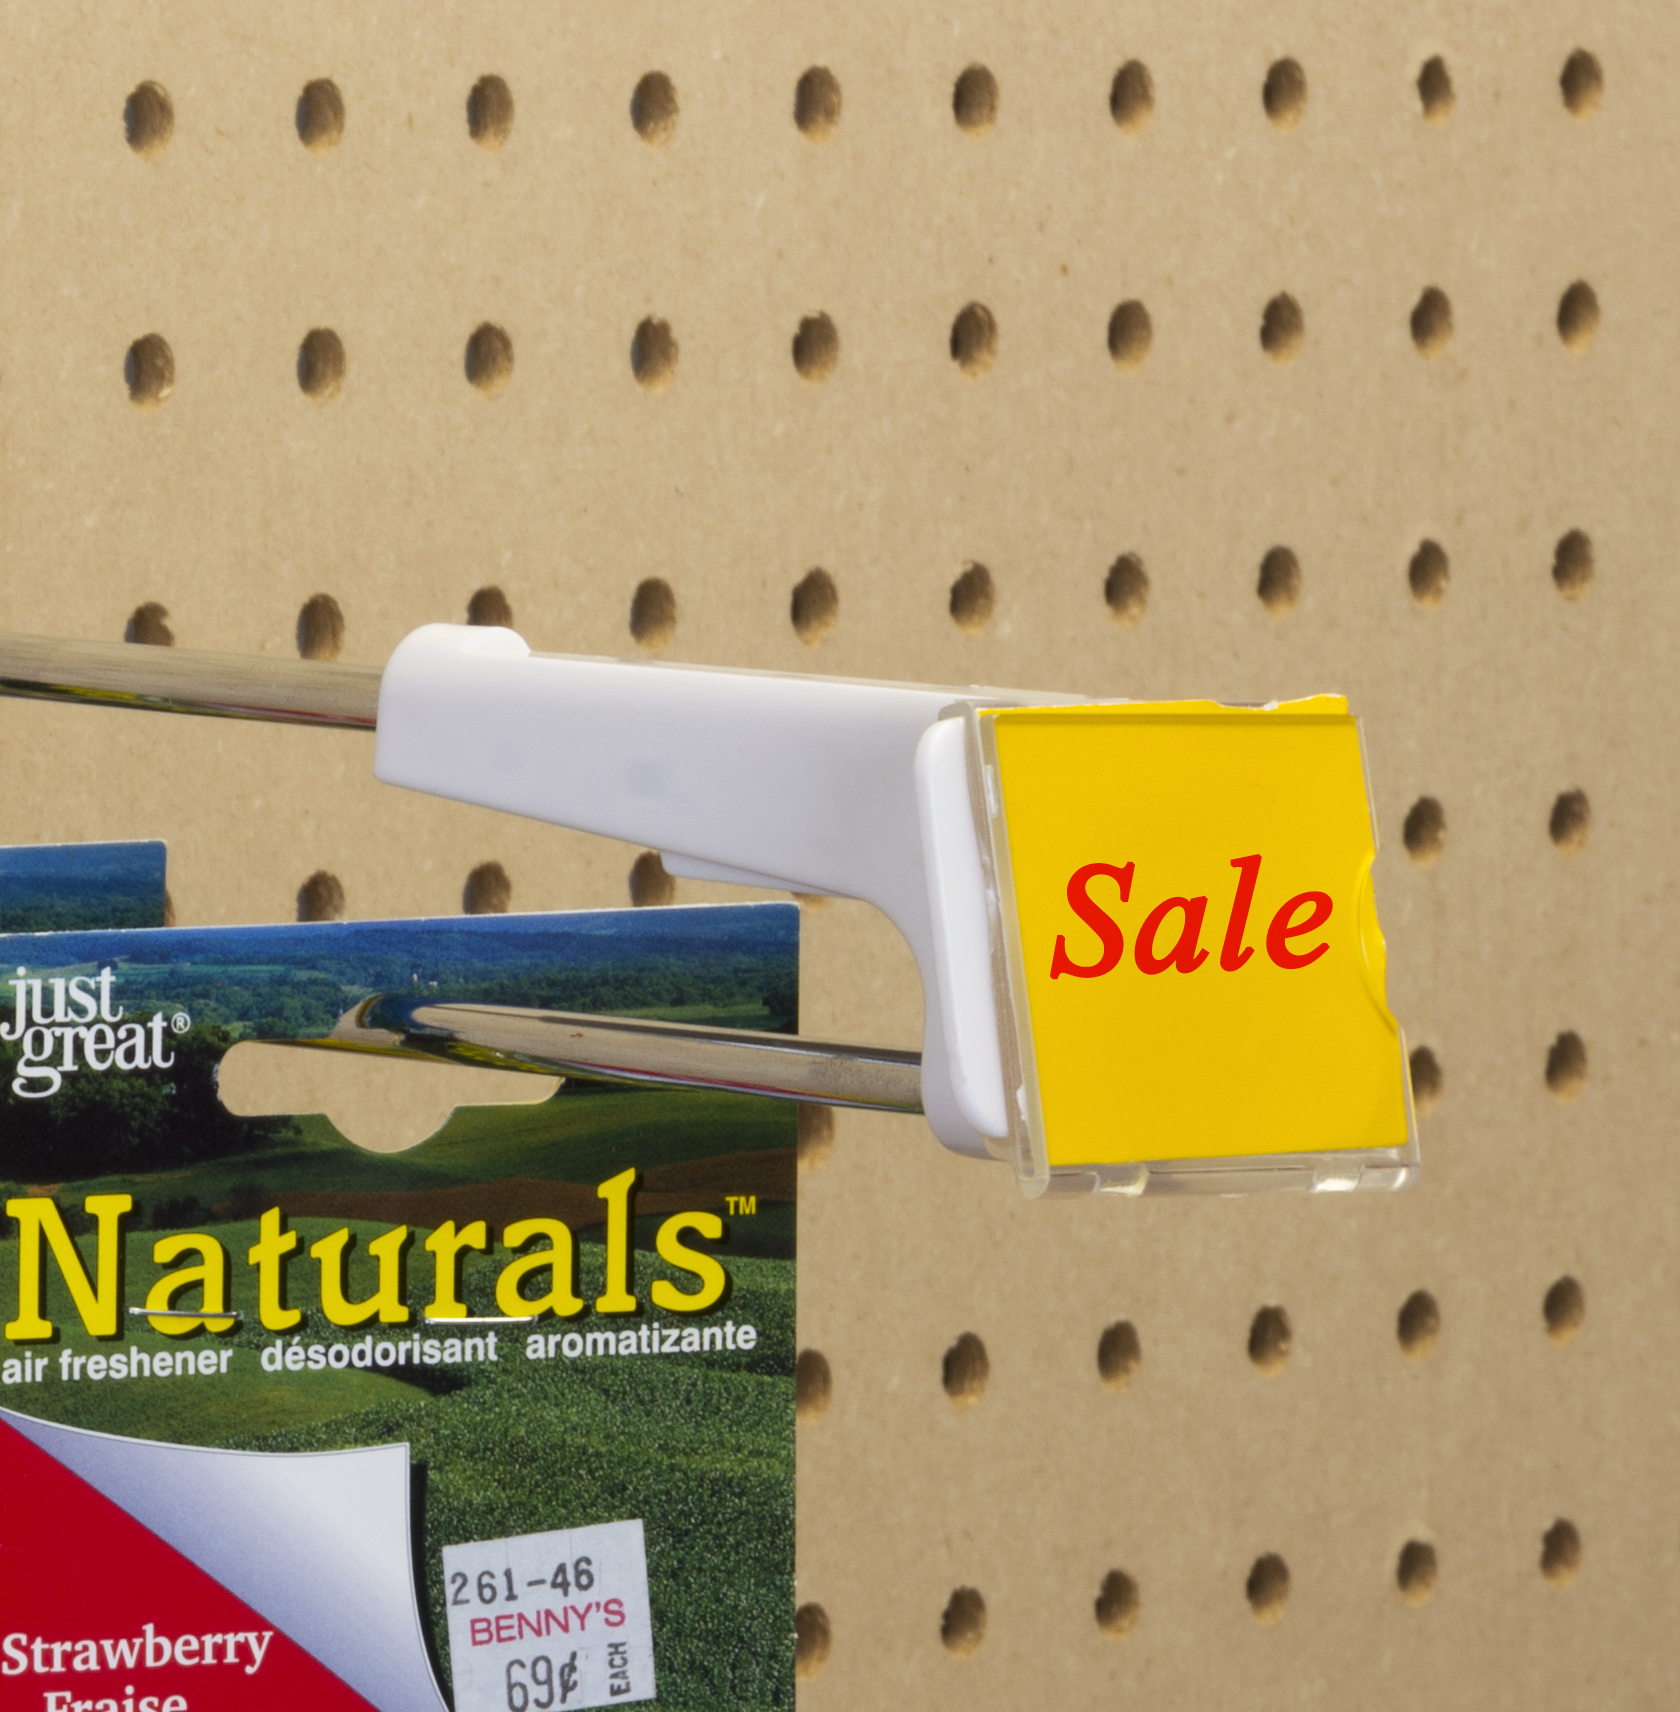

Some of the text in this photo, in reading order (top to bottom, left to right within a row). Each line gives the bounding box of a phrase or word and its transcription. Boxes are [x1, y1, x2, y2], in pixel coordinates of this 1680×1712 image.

[1050, 853, 1333, 979] Sale
[2, 1321, 758, 1384] air freshener désodorisant aromatizante
[450, 1556, 595, 1606] 261-46
[1, 1623, 274, 1675] Strawberry
[470, 1598, 626, 1646] BENNY'S
[505, 1651, 578, 1712] 69¢
[607, 1641, 631, 1697] EACH
